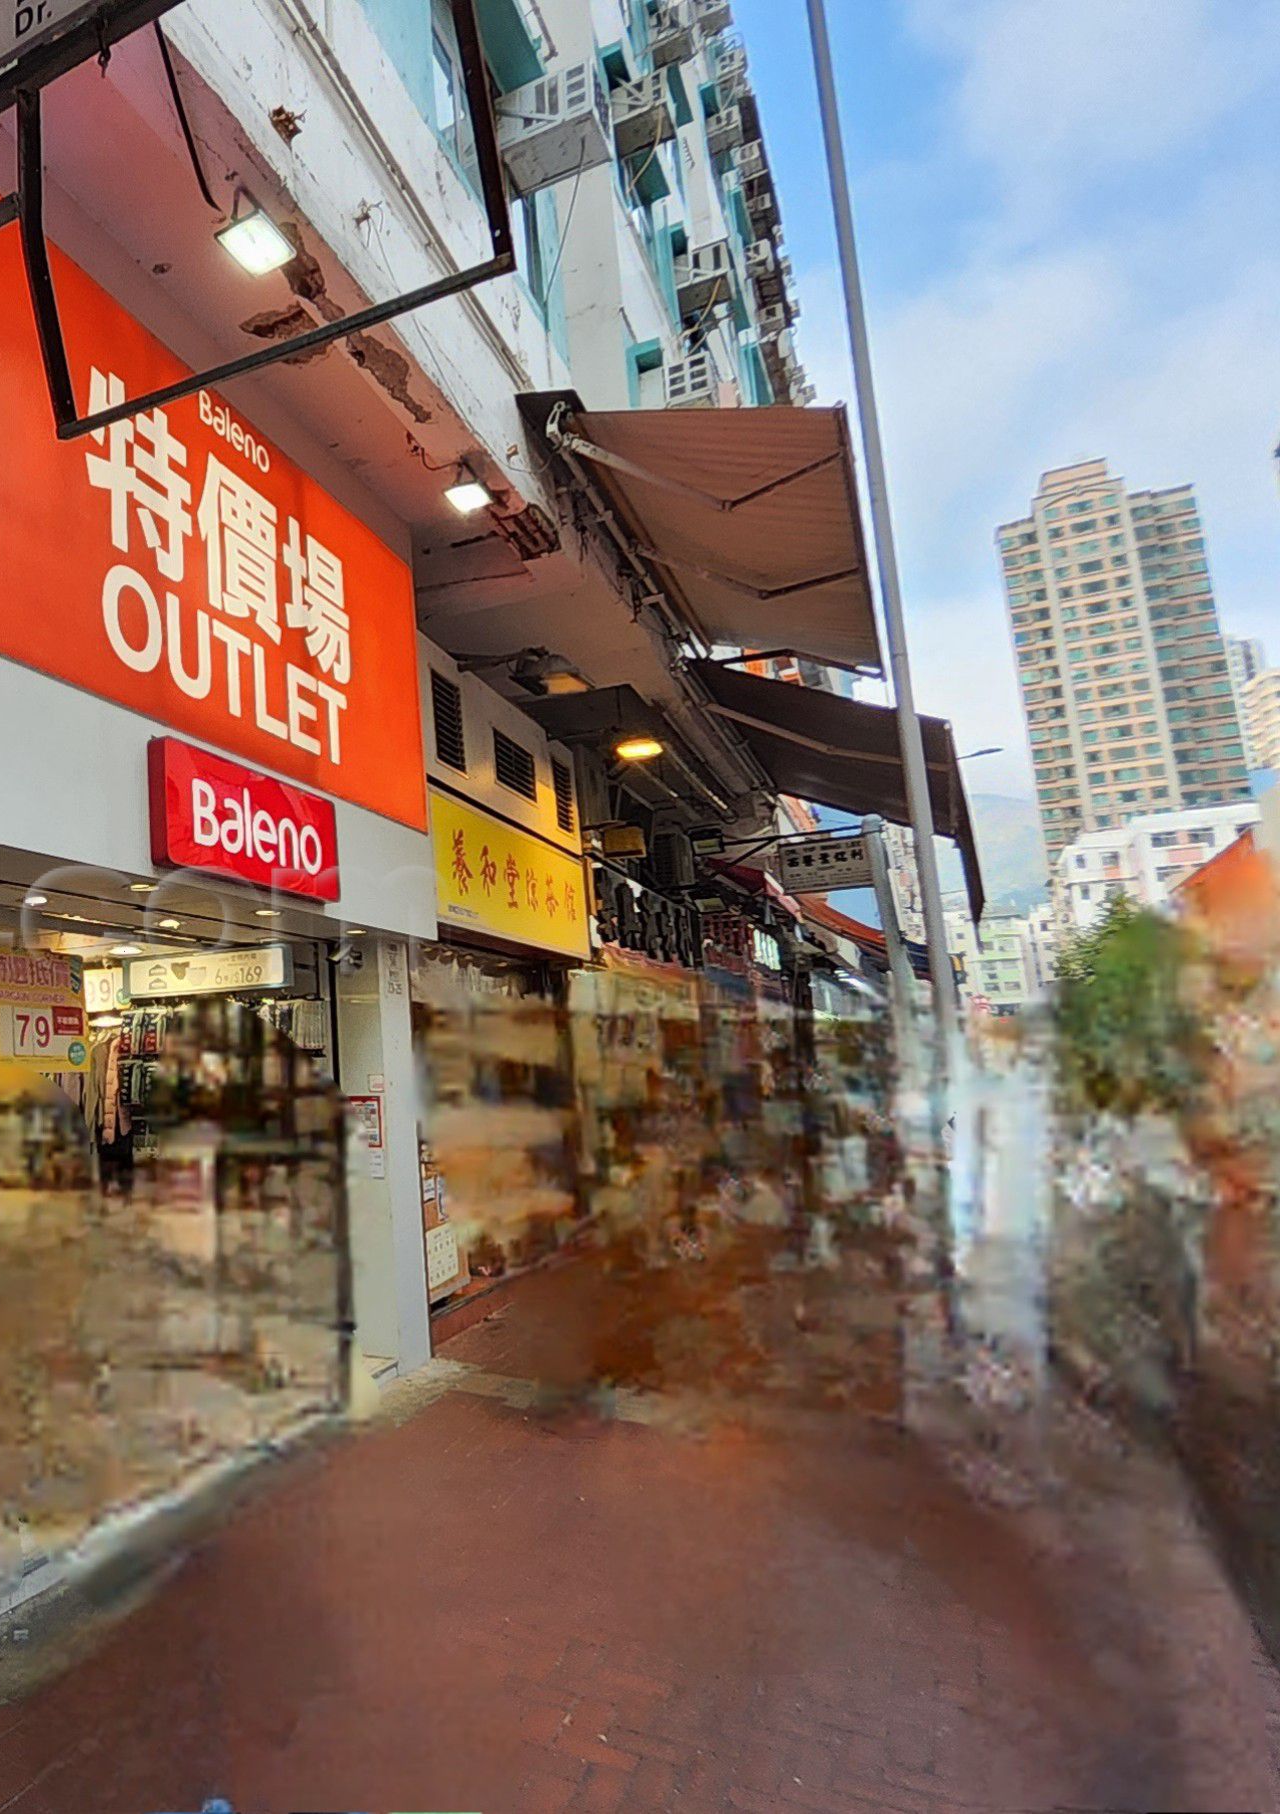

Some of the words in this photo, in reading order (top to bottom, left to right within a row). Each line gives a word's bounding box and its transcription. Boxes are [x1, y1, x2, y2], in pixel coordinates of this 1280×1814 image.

[198, 390, 270, 473] Baleno
[85, 365, 351, 684] 特價場
[102, 564, 347, 766] OUTLET
[192, 778, 322, 875] Baleno
